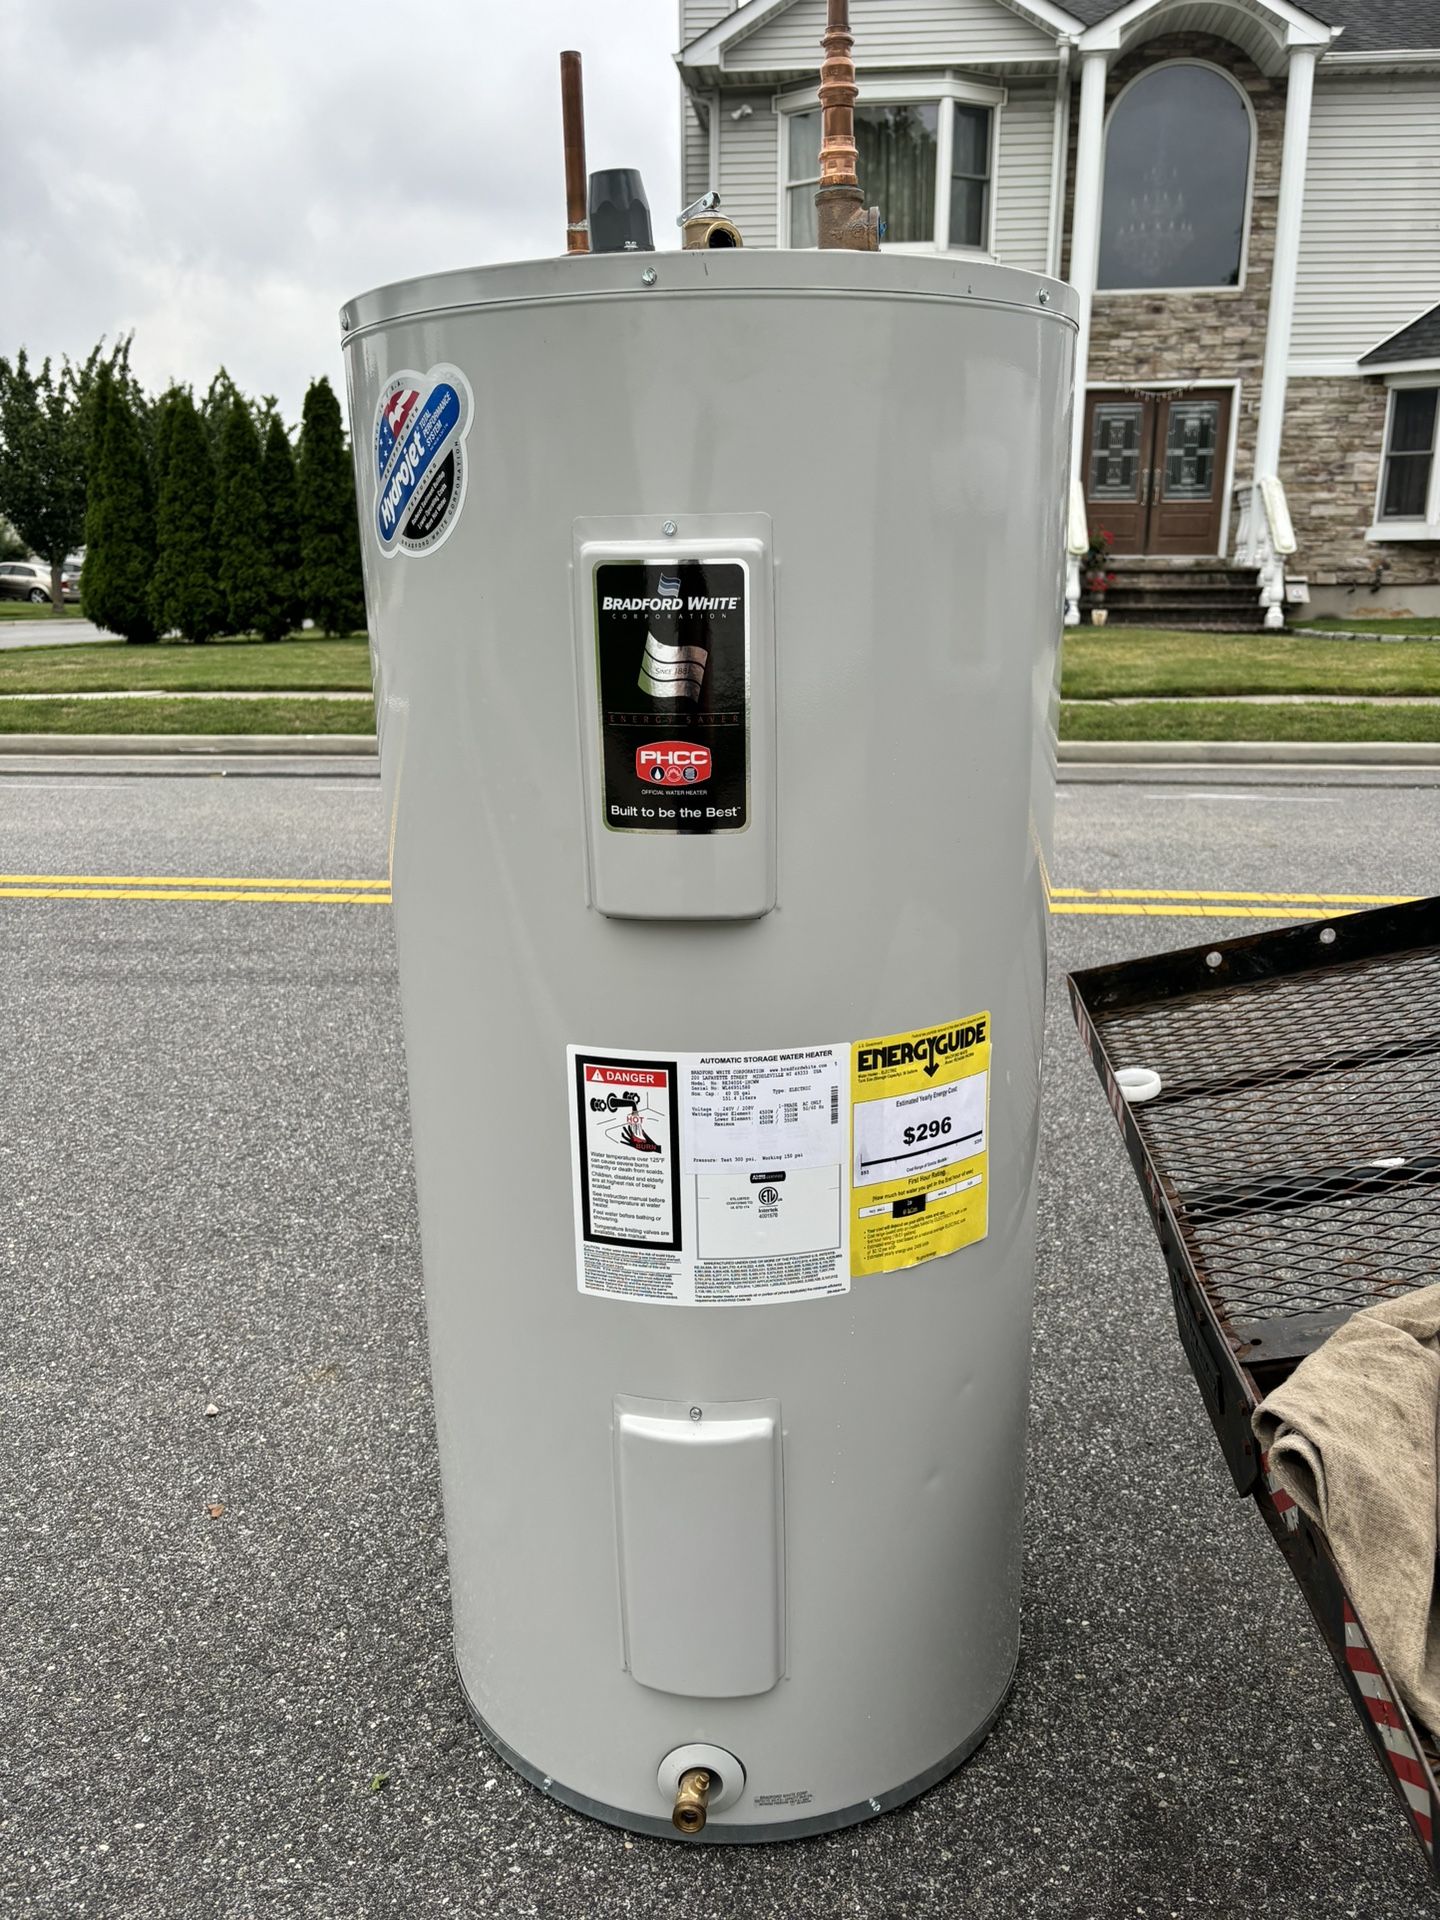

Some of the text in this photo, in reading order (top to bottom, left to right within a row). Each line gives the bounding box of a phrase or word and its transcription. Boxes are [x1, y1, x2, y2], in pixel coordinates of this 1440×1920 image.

[419, 409, 431, 429] TOTAL
[422, 391, 452, 439] PERFORMANCE
[427, 420, 442, 447] SYSTEM
[381, 430, 425, 530] Hydrojet
[448, 441, 462, 515] CORPORATION
[408, 462, 437, 511] FEATURING
[602, 596, 738, 611] BRADFORD WHITE
[610, 714, 739, 724] ENERGY SAVER
[640, 750, 708, 765] PHCC
[611, 804, 639, 817] Built
[641, 806, 656, 817] to
[658, 806, 676, 818] be
[679, 806, 702, 818] the
[858, 1020, 987, 1073] ENERGYGUIDE
[700, 1050, 833, 1064] AUTOMATIC STORAGE WATER HEATER
[606, 1071, 655, 1084] DANGER
[896, 1086, 958, 1108] Estimated Yearly Energy Cost
[903, 1116, 952, 1146] $296
[606, 1152, 636, 1161] temperature
[905, 1188, 918, 1196] water
[917, 1186, 926, 1194] you
[937, 1178, 945, 1186] the
[944, 1175, 952, 1184] first
[951, 1174, 960, 1182] hour
[908, 1170, 946, 1185] First Hour Rating
[603, 1192, 628, 1200] instruction
[636, 1214, 655, 1222] bathing
[594, 1222, 624, 1231] Temperature
